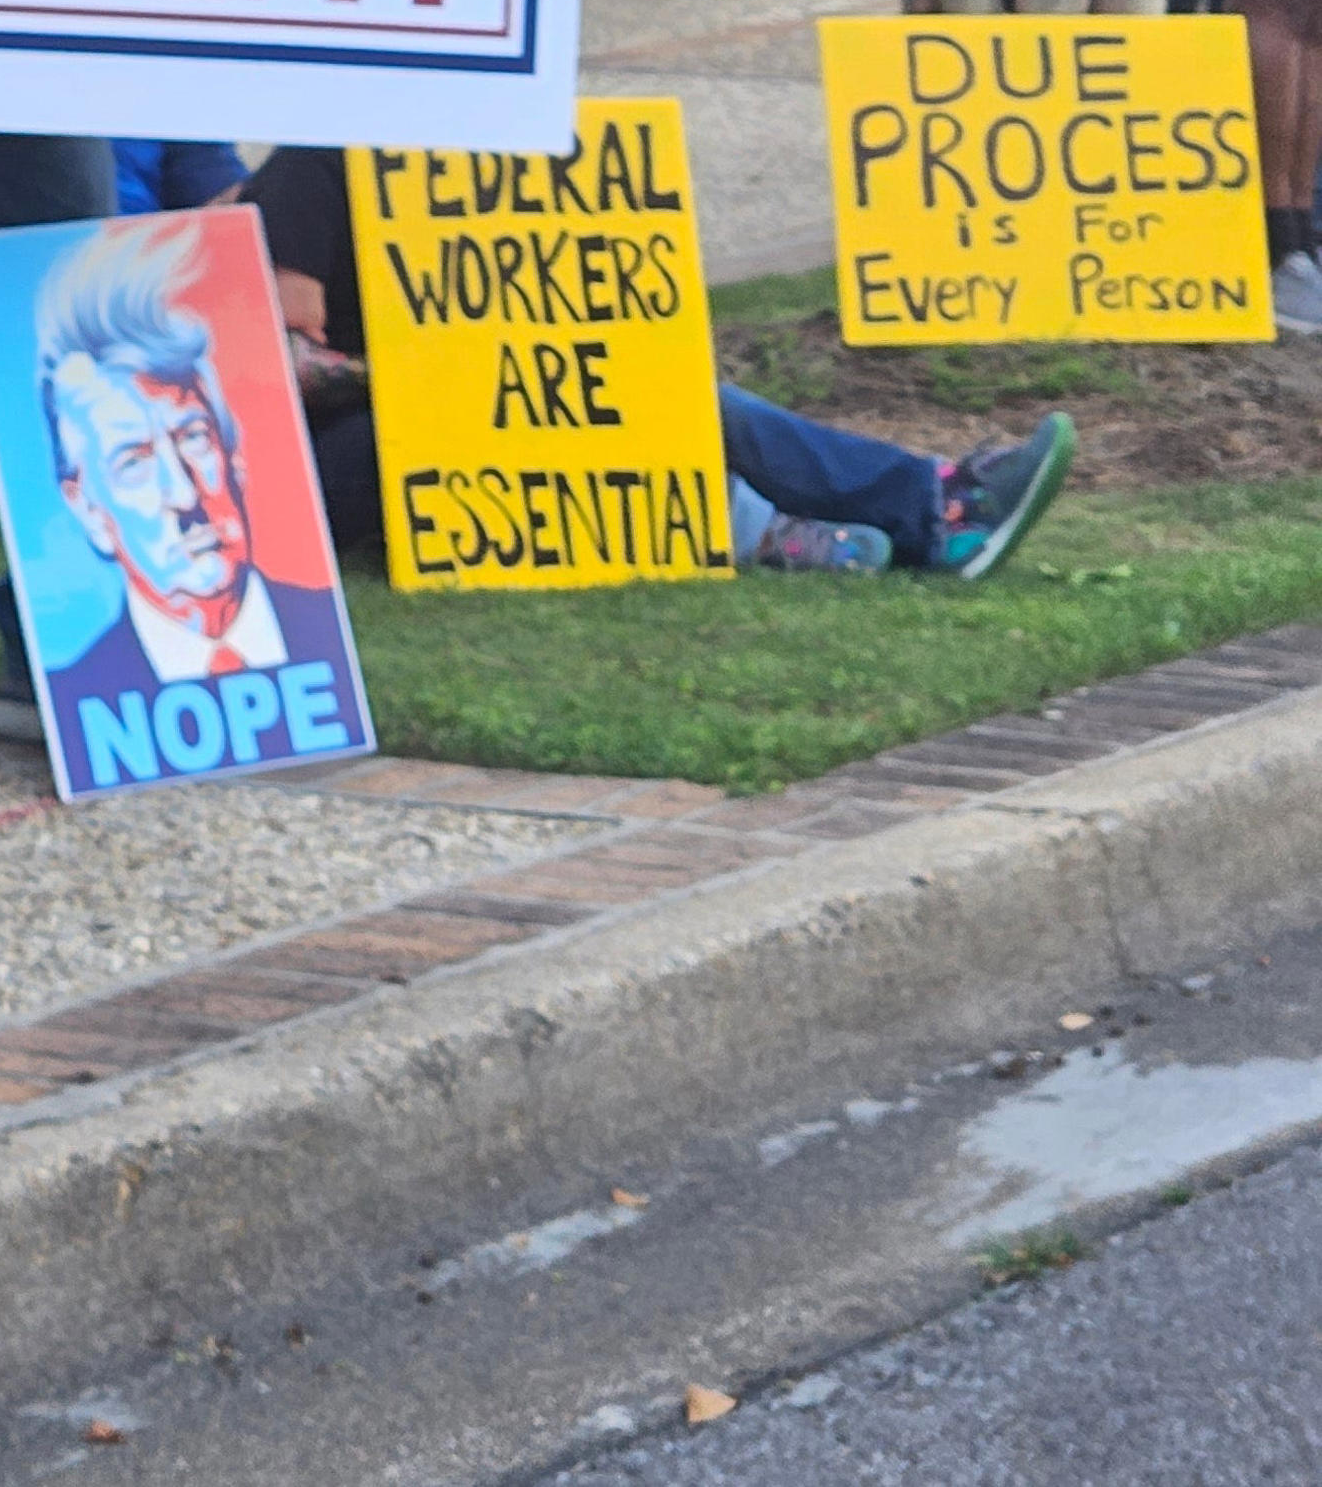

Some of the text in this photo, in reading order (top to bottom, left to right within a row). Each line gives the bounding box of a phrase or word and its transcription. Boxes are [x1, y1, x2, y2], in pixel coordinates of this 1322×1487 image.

[907, 33, 1130, 106] DUE
[370, 122, 682, 219] FEDERAL
[850, 103, 1252, 209] PROCESS
[1073, 203, 1165, 245] For
[385, 228, 681, 326] WORKERS
[854, 251, 1018, 325] Every
[492, 340, 622, 429] ARE
[403, 466, 730, 575] ESSENTIAL
[76, 660, 350, 788] NOPE
